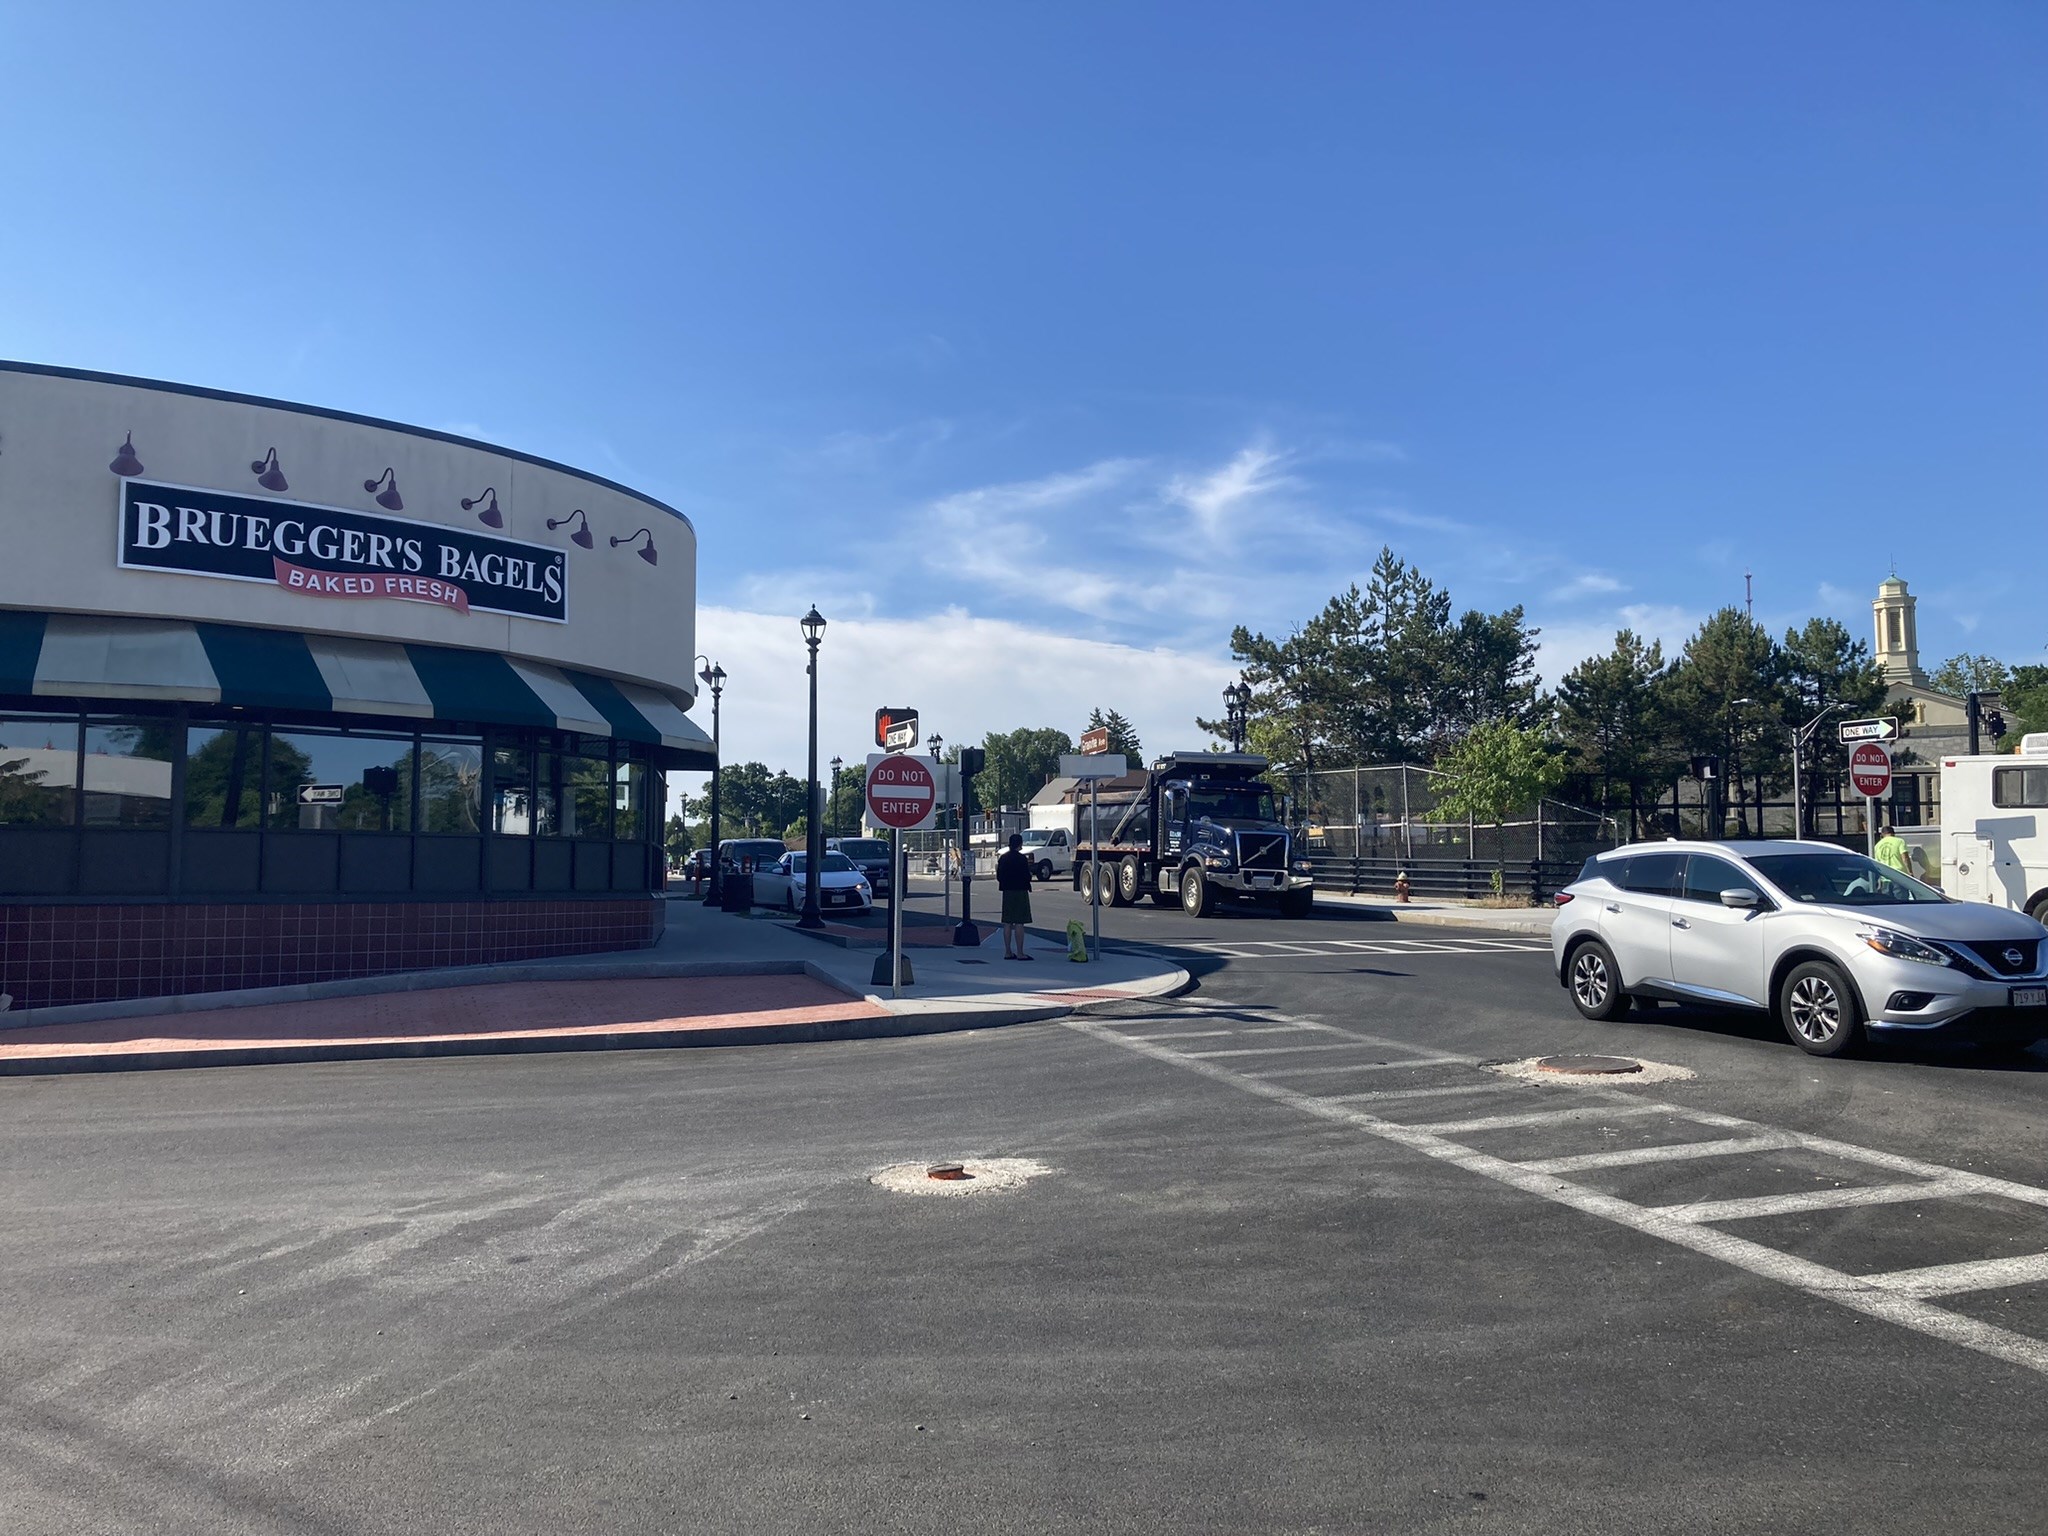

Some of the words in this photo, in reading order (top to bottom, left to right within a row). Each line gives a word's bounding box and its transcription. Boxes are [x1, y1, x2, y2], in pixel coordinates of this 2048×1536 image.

[131, 501, 423, 572] BRUEGGER'S
[437, 544, 563, 604] BAGELS
[287, 568, 377, 595] BAKED
[384, 577, 459, 604] FRESH
[1844, 727, 1860, 737] ONE
[1862, 725, 1879, 735] WAY
[888, 733, 897, 746] ONE
[897, 731, 908, 744] WAY
[1856, 753, 1867, 762] DO
[1869, 754, 1885, 763] NOT
[878, 769, 895, 781] DO
[901, 770, 925, 782] NOT
[1859, 777, 1883, 787] ENTER
[882, 801, 920, 814] ENTER
